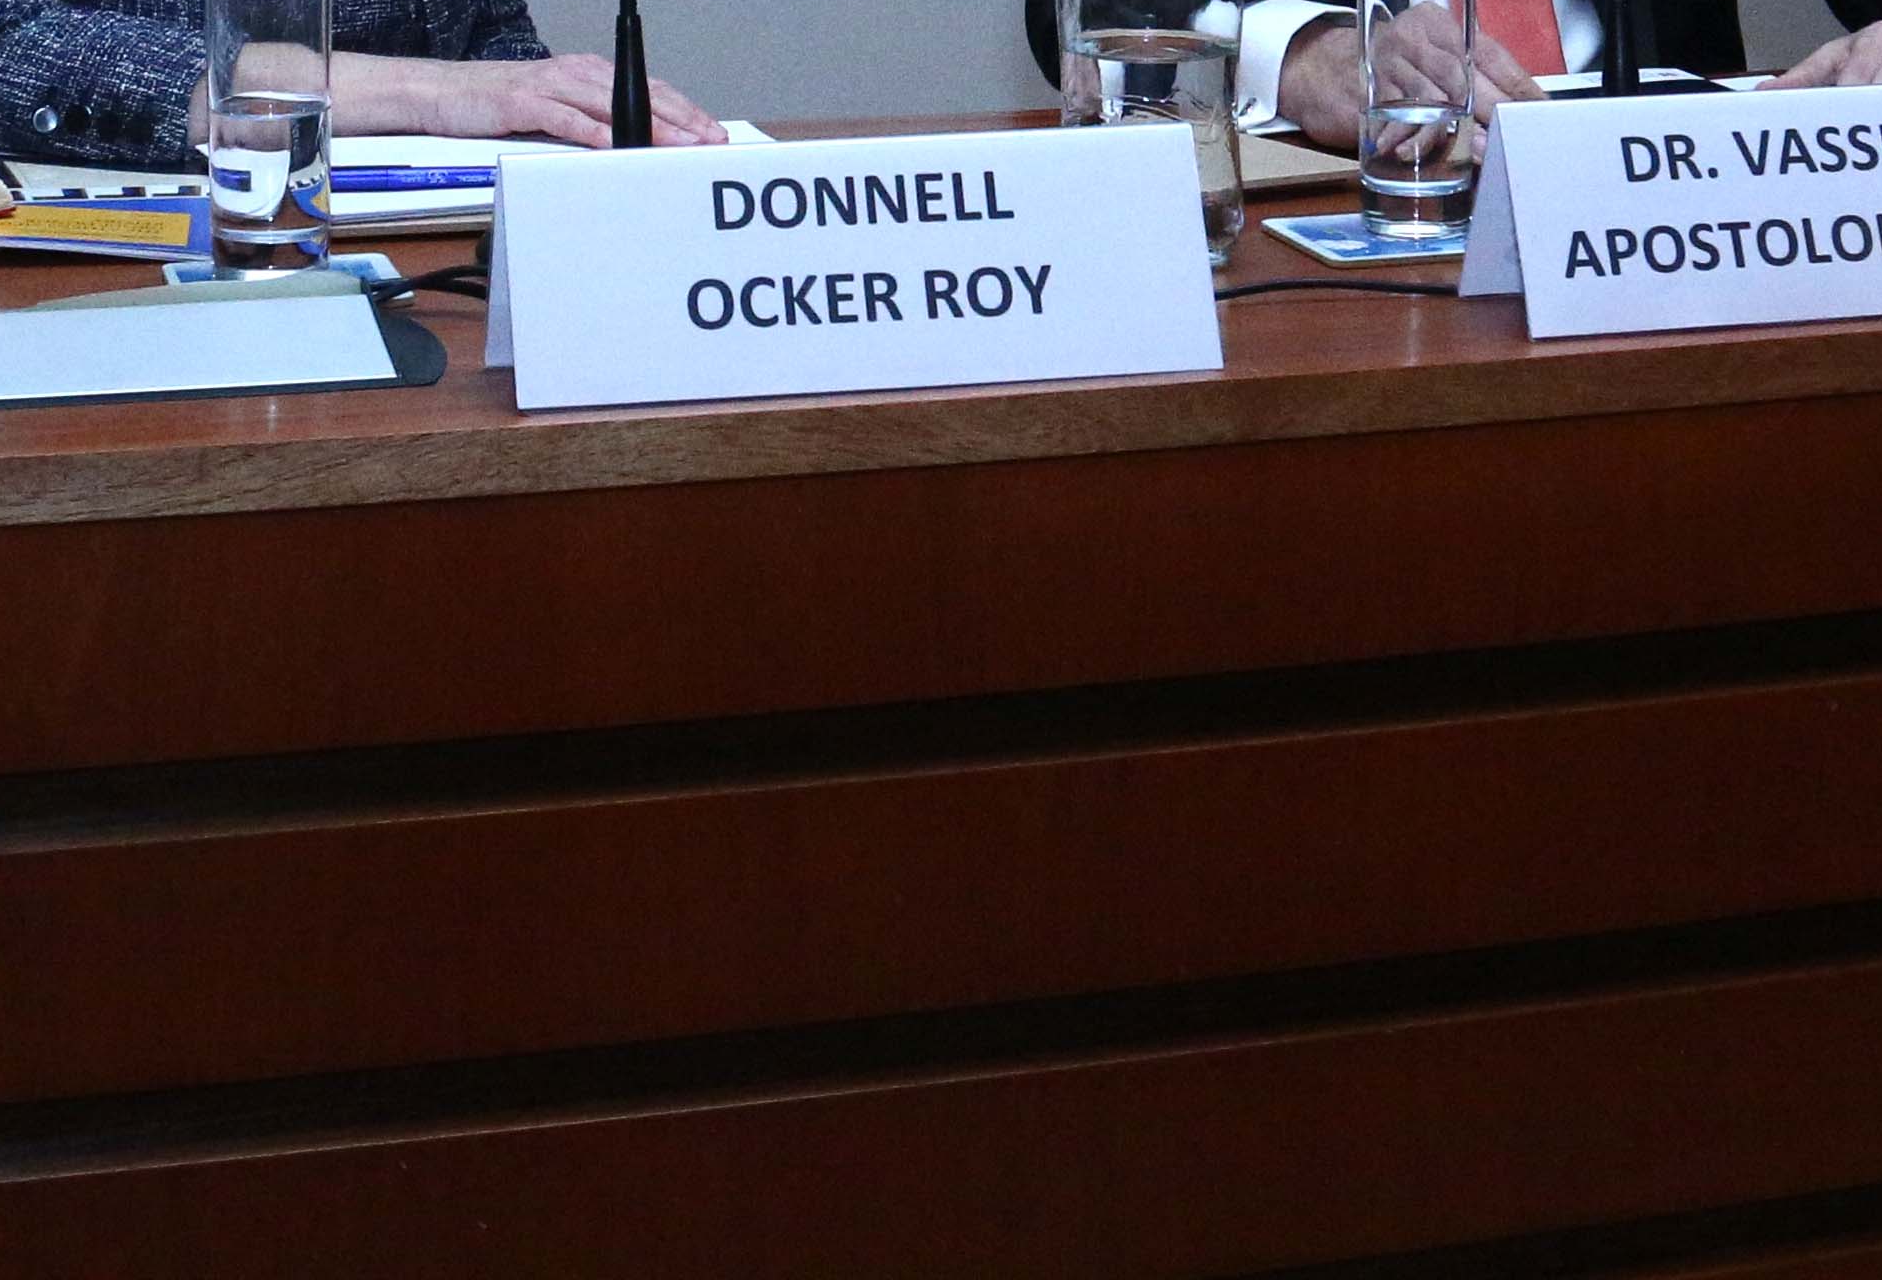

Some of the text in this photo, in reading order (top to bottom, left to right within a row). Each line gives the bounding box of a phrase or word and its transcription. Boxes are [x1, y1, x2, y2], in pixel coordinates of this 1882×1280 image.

[1620, 133, 1719, 183] DR.
[711, 170, 1015, 231] DONNELL
[686, 264, 1052, 331] OCKER ROY
